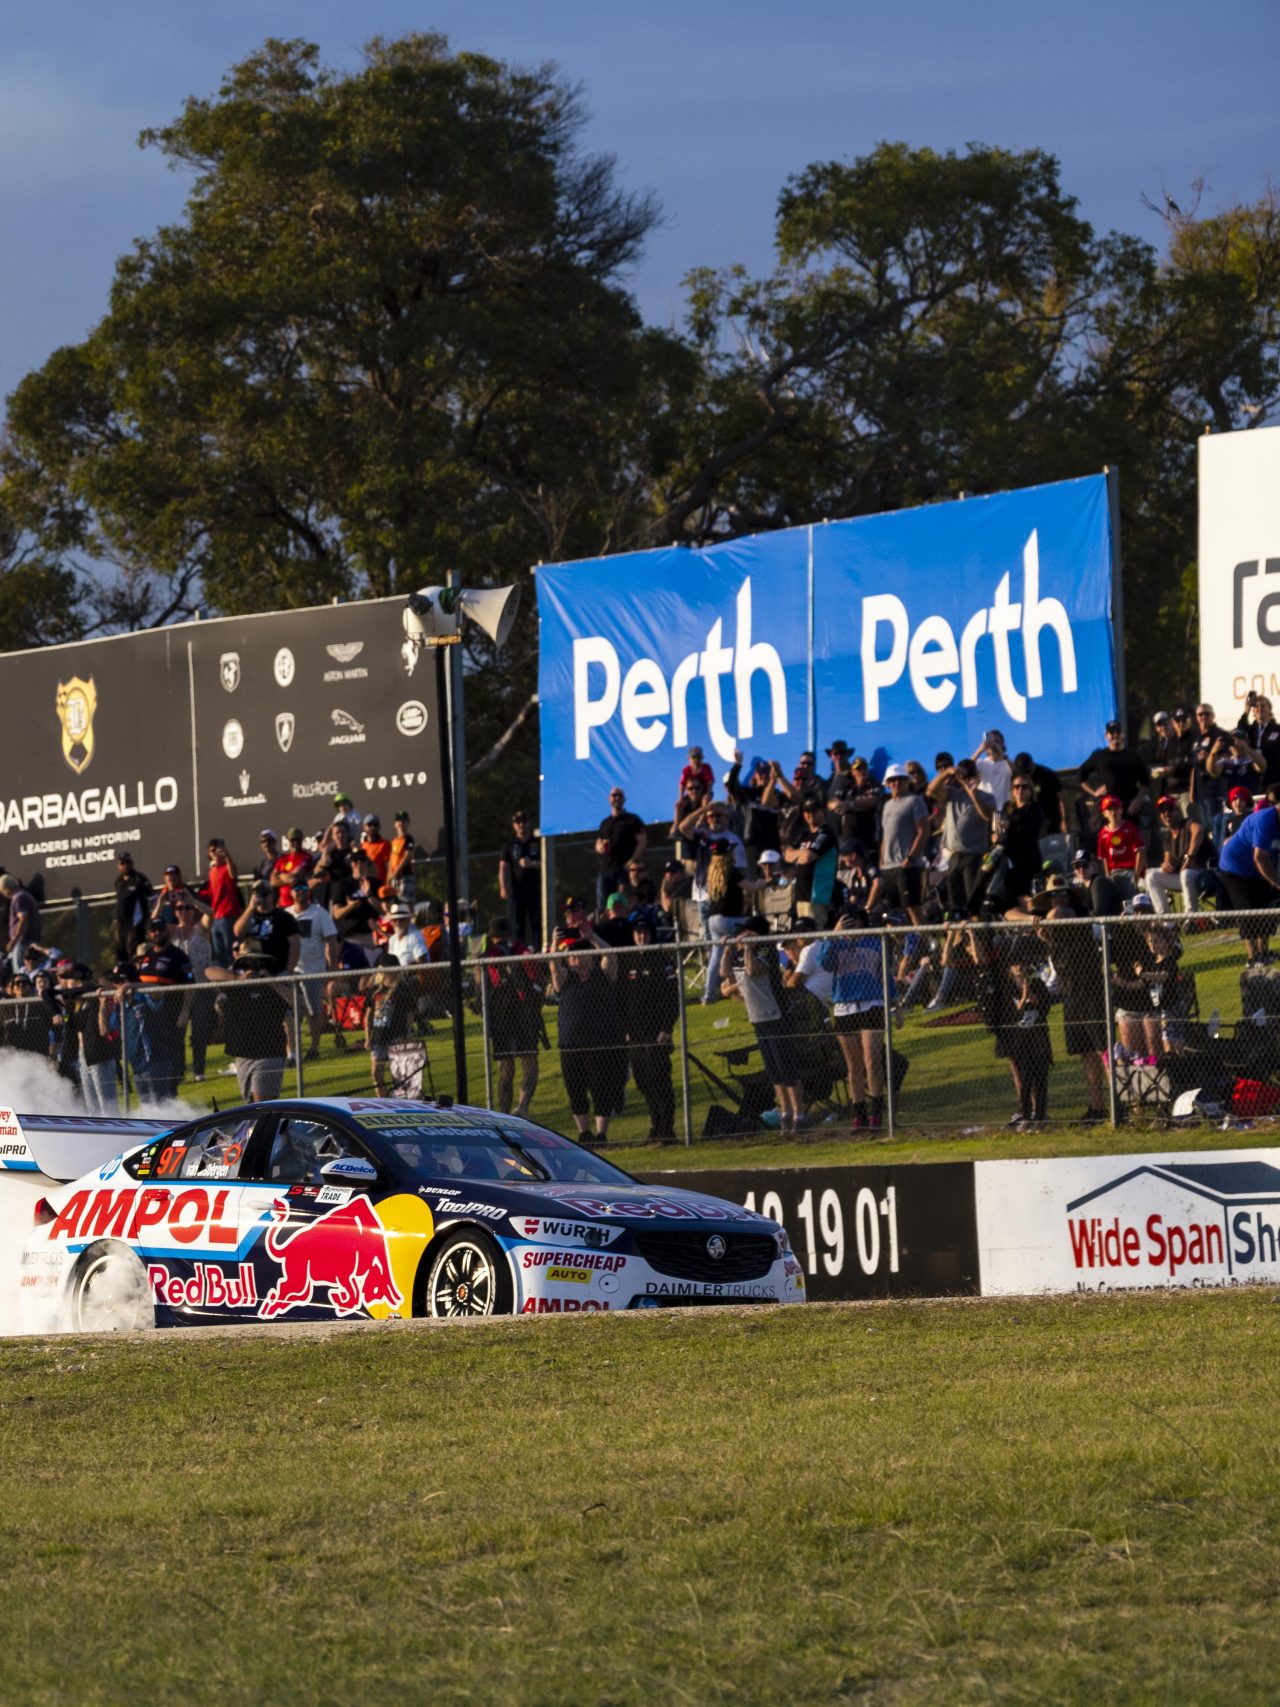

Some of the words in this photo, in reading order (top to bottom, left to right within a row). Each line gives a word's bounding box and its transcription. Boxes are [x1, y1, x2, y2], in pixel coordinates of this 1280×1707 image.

[861, 527, 1078, 724] Perth
[573, 575, 788, 763] Perth
[328, 733, 367, 746] JAGUAR
[363, 771, 427, 790] VOLVO
[20, 839, 69, 856] LEADERS
[70, 838, 82, 849] IN
[84, 829, 141, 848] MOTORING
[45, 849, 115, 869] EXCELLENCE
[379, 1128, 415, 1139] van
[421, 1126, 520, 1140] Gisbergn
[101, 1156, 122, 1180] hp
[156, 1146, 188, 1175] 97
[330, 1163, 375, 1174] ACDelco
[320, 1192, 342, 1201] TRADE
[424, 1187, 462, 1196] DUNLOP
[48, 1188, 238, 1244] AMPOL
[435, 1198, 508, 1220] ToolPRO
[543, 1221, 610, 1243] WÜRTH
[797, 1188, 844, 1277] 19
[856, 1186, 899, 1275] 01
[1232, 1211, 1280, 1265] Sh
[1068, 1217, 1140, 1269] Wide
[1146, 1213, 1224, 1277] Span
[523, 1251, 627, 1273] SUPERCHEAP
[205, 1262, 258, 1308] Bull
[550, 1269, 588, 1281] AUTO
